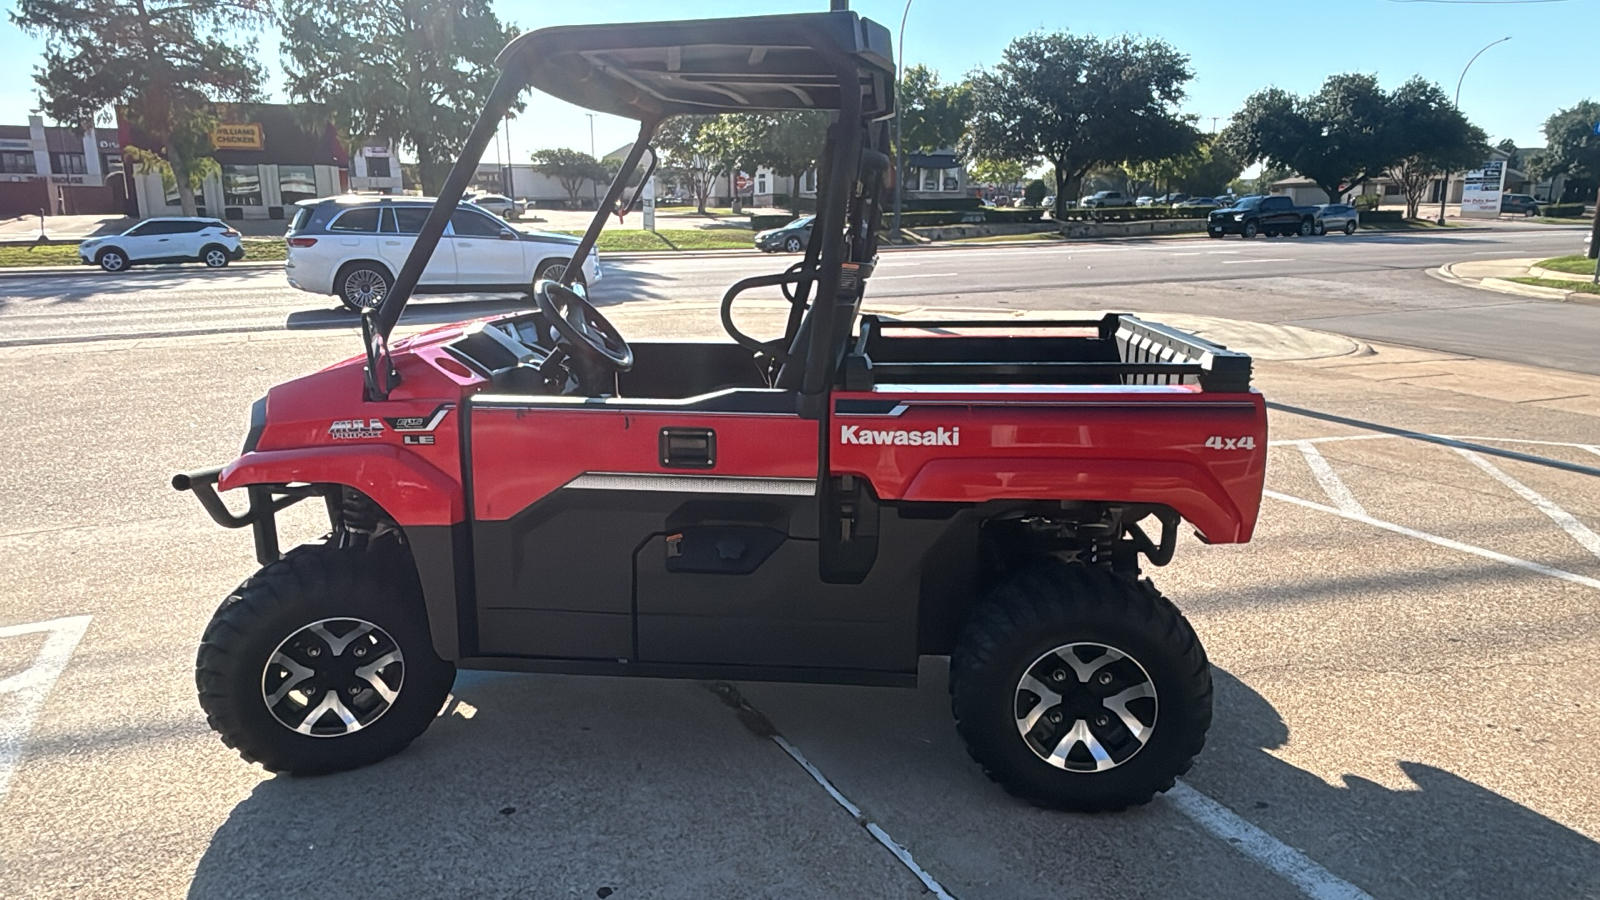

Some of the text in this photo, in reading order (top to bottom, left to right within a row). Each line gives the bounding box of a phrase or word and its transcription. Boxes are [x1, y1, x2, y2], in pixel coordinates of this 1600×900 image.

[404, 435, 435, 445] LE
[841, 425, 960, 446] Kawasaki
[1205, 436, 1256, 450] 4x4
